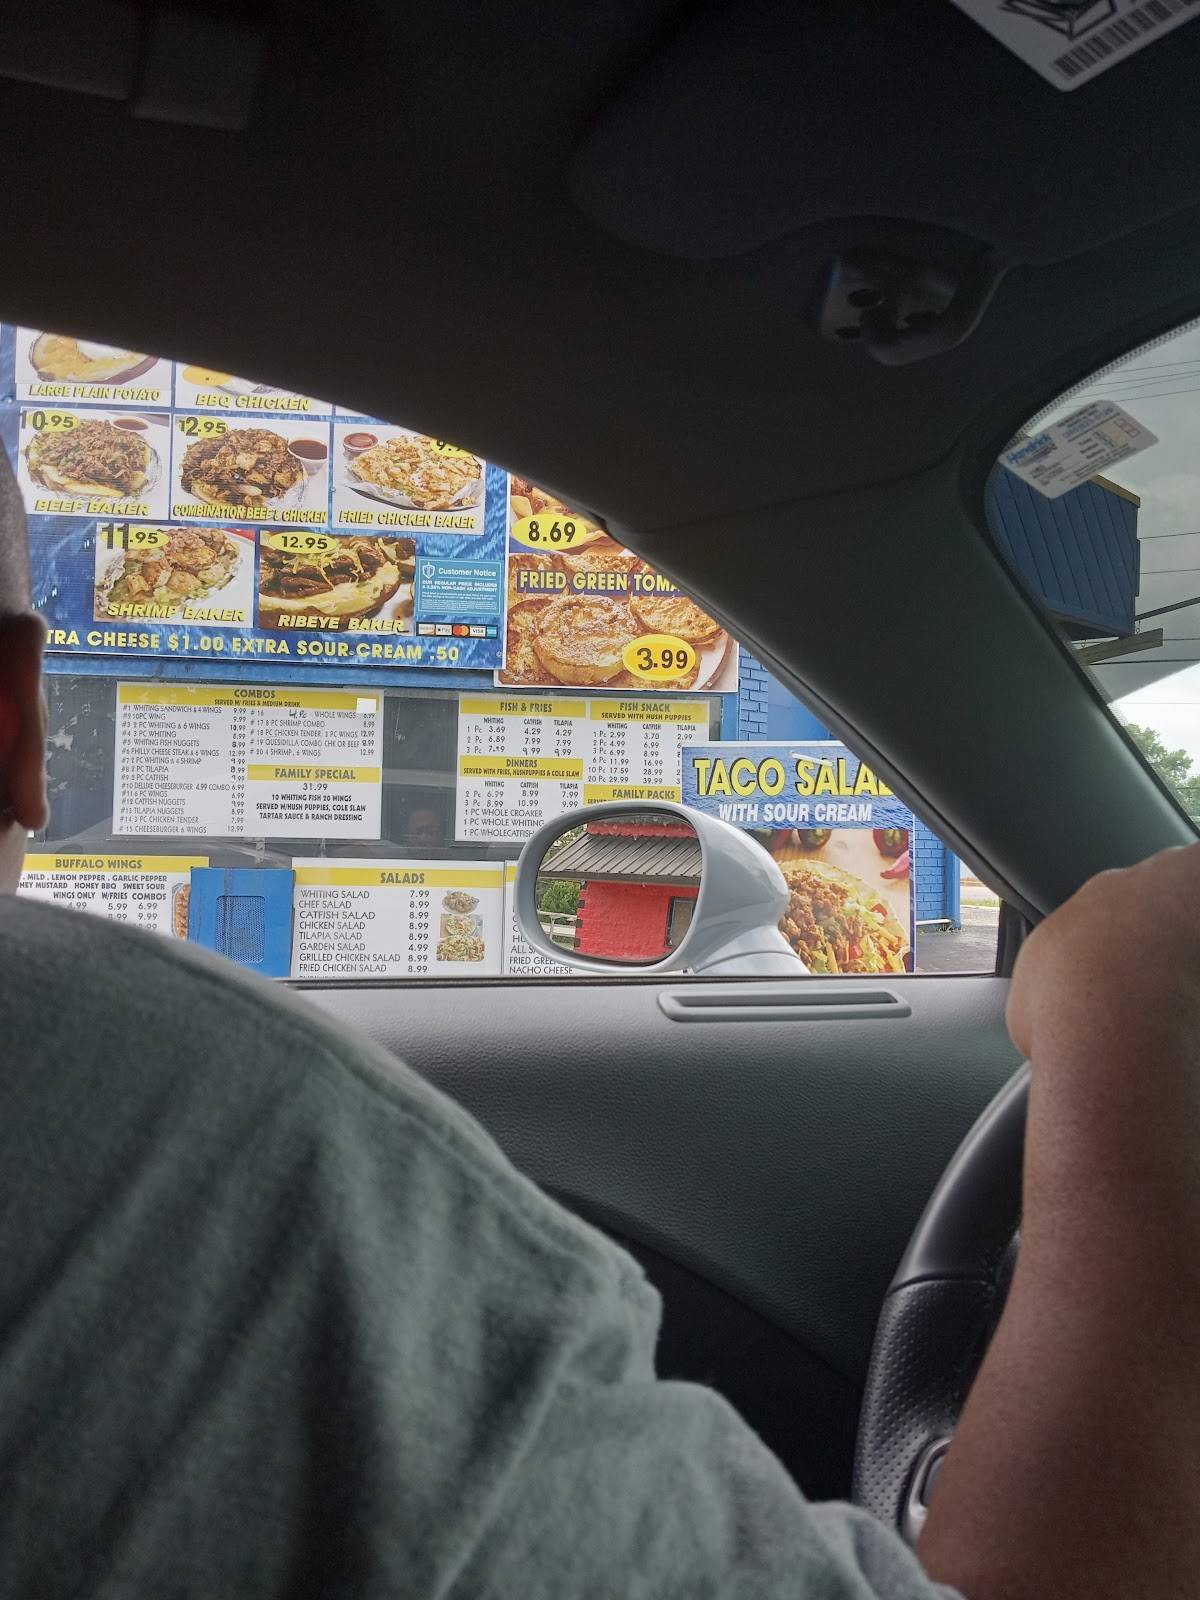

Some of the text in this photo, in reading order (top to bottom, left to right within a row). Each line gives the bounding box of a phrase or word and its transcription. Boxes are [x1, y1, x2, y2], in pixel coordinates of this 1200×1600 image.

[29, 384, 161, 401] LARGE PLAIN POTATO
[196, 393, 311, 411] BBQ CHICKEN
[179, 417, 228, 437] 12.95
[35, 499, 151, 516] BEEF BAKER
[172, 504, 246, 519] COMBINATION
[282, 508, 327, 523] CHICKEN
[338, 510, 477, 529] FRIED CHICKEN BAKER
[101, 523, 159, 550] 11.95
[528, 521, 576, 543] 8.69
[281, 535, 328, 550] 12.95
[438, 568, 497, 577] Customer Notice
[520, 571, 567, 590] FRIED
[573, 572, 628, 591] GREEN
[107, 603, 245, 622] SHRIMP BAKER
[278, 615, 407, 632] RIBEYE BAKER
[46, 630, 459, 661] TRA CHEESE $1.00 EXTRA SOUR CREAM .50
[637, 648, 688, 671] 3.99
[234, 689, 276, 698] COMBOS
[500, 702, 553, 712] FISH & FRIES
[620, 702, 671, 712] FISH SNACK
[488, 725, 573, 737] 3.69 4.29 4.29
[524, 737, 541, 745] 7.99
[555, 739, 571, 747] 7.99
[506, 759, 538, 768] DINNERS
[275, 768, 356, 780] FAMILY SPECIAL
[693, 757, 786, 796] TACO
[302, 783, 328, 791] 31.99
[612, 789, 675, 800] FAMILY PACKS
[482, 809, 543, 817] WHOLE CROAKER
[719, 803, 873, 822] WITH SOUR CREAM
[55, 858, 143, 869] BUFFALO WINGS
[27, 873, 46, 881] MILD
[79, 874, 106, 882] PEPPER
[380, 872, 425, 884] SALADS
[74, 882, 99, 890] HONEY
[101, 883, 117, 891] BBQ
[53, 891, 167, 901] WINGS ONLY W/FRIES COMBOS
[300, 889, 430, 899] WHITING SALAD 7.99
[108, 903, 128, 911] 5.99
[299, 900, 430, 909] CHEF SALAD 8.99
[138, 913, 158, 921] 9.99
[299, 911, 376, 920] CATFISH SALAD
[299, 921, 366, 930] CHICKEN SALAD
[299, 932, 362, 940] TILAPIA SALAD
[299, 943, 429, 952] GARDEN SALAD 4.99
[510, 945, 527, 954] ALL
[299, 953, 429, 963] GRILLED CHICKEN SALAD 8.99
[509, 956, 532, 965] FRIED
[299, 964, 428, 973] FRIED CHICKEN SALAD 8.99
[509, 966, 574, 975] NACHO CHEESE
